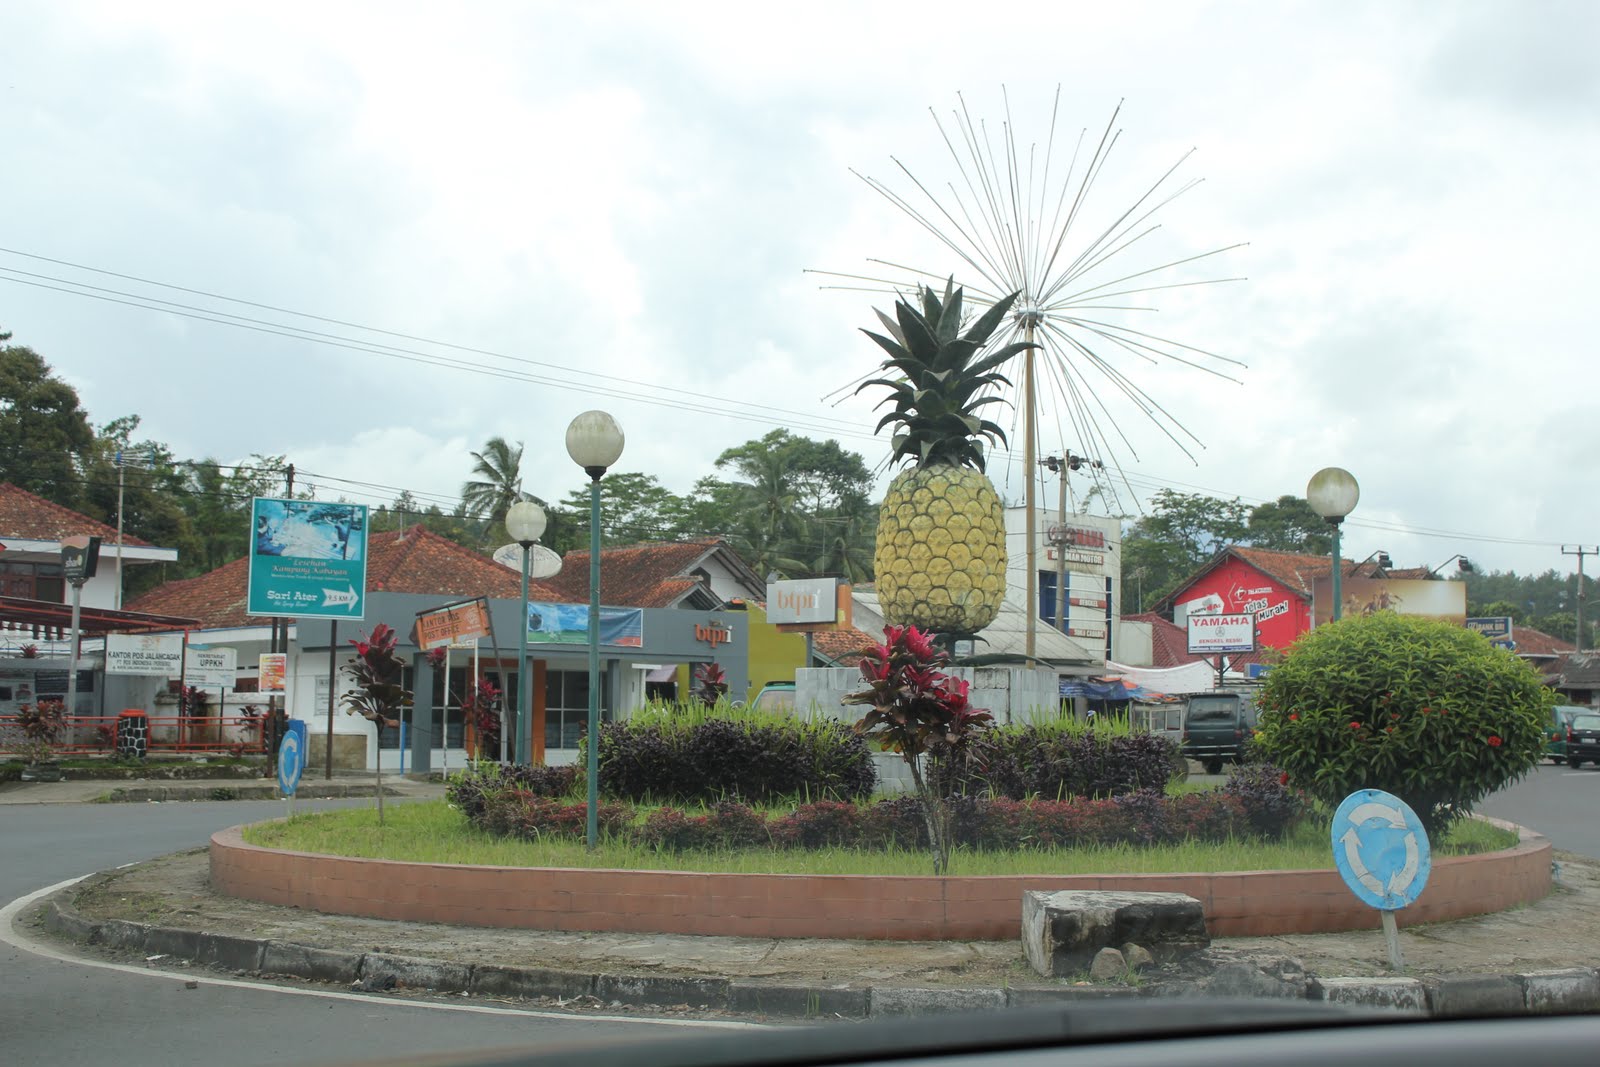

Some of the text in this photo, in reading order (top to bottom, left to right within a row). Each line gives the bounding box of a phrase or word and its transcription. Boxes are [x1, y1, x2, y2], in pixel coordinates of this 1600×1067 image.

[266, 590, 318, 601] Sari Ater
[1193, 617, 1249, 627] YAMAHA
[424, 629, 440, 640] POST
[108, 651, 131, 659] KANTOR
[132, 652, 144, 660] POS
[200, 659, 223, 667] UPPKH
